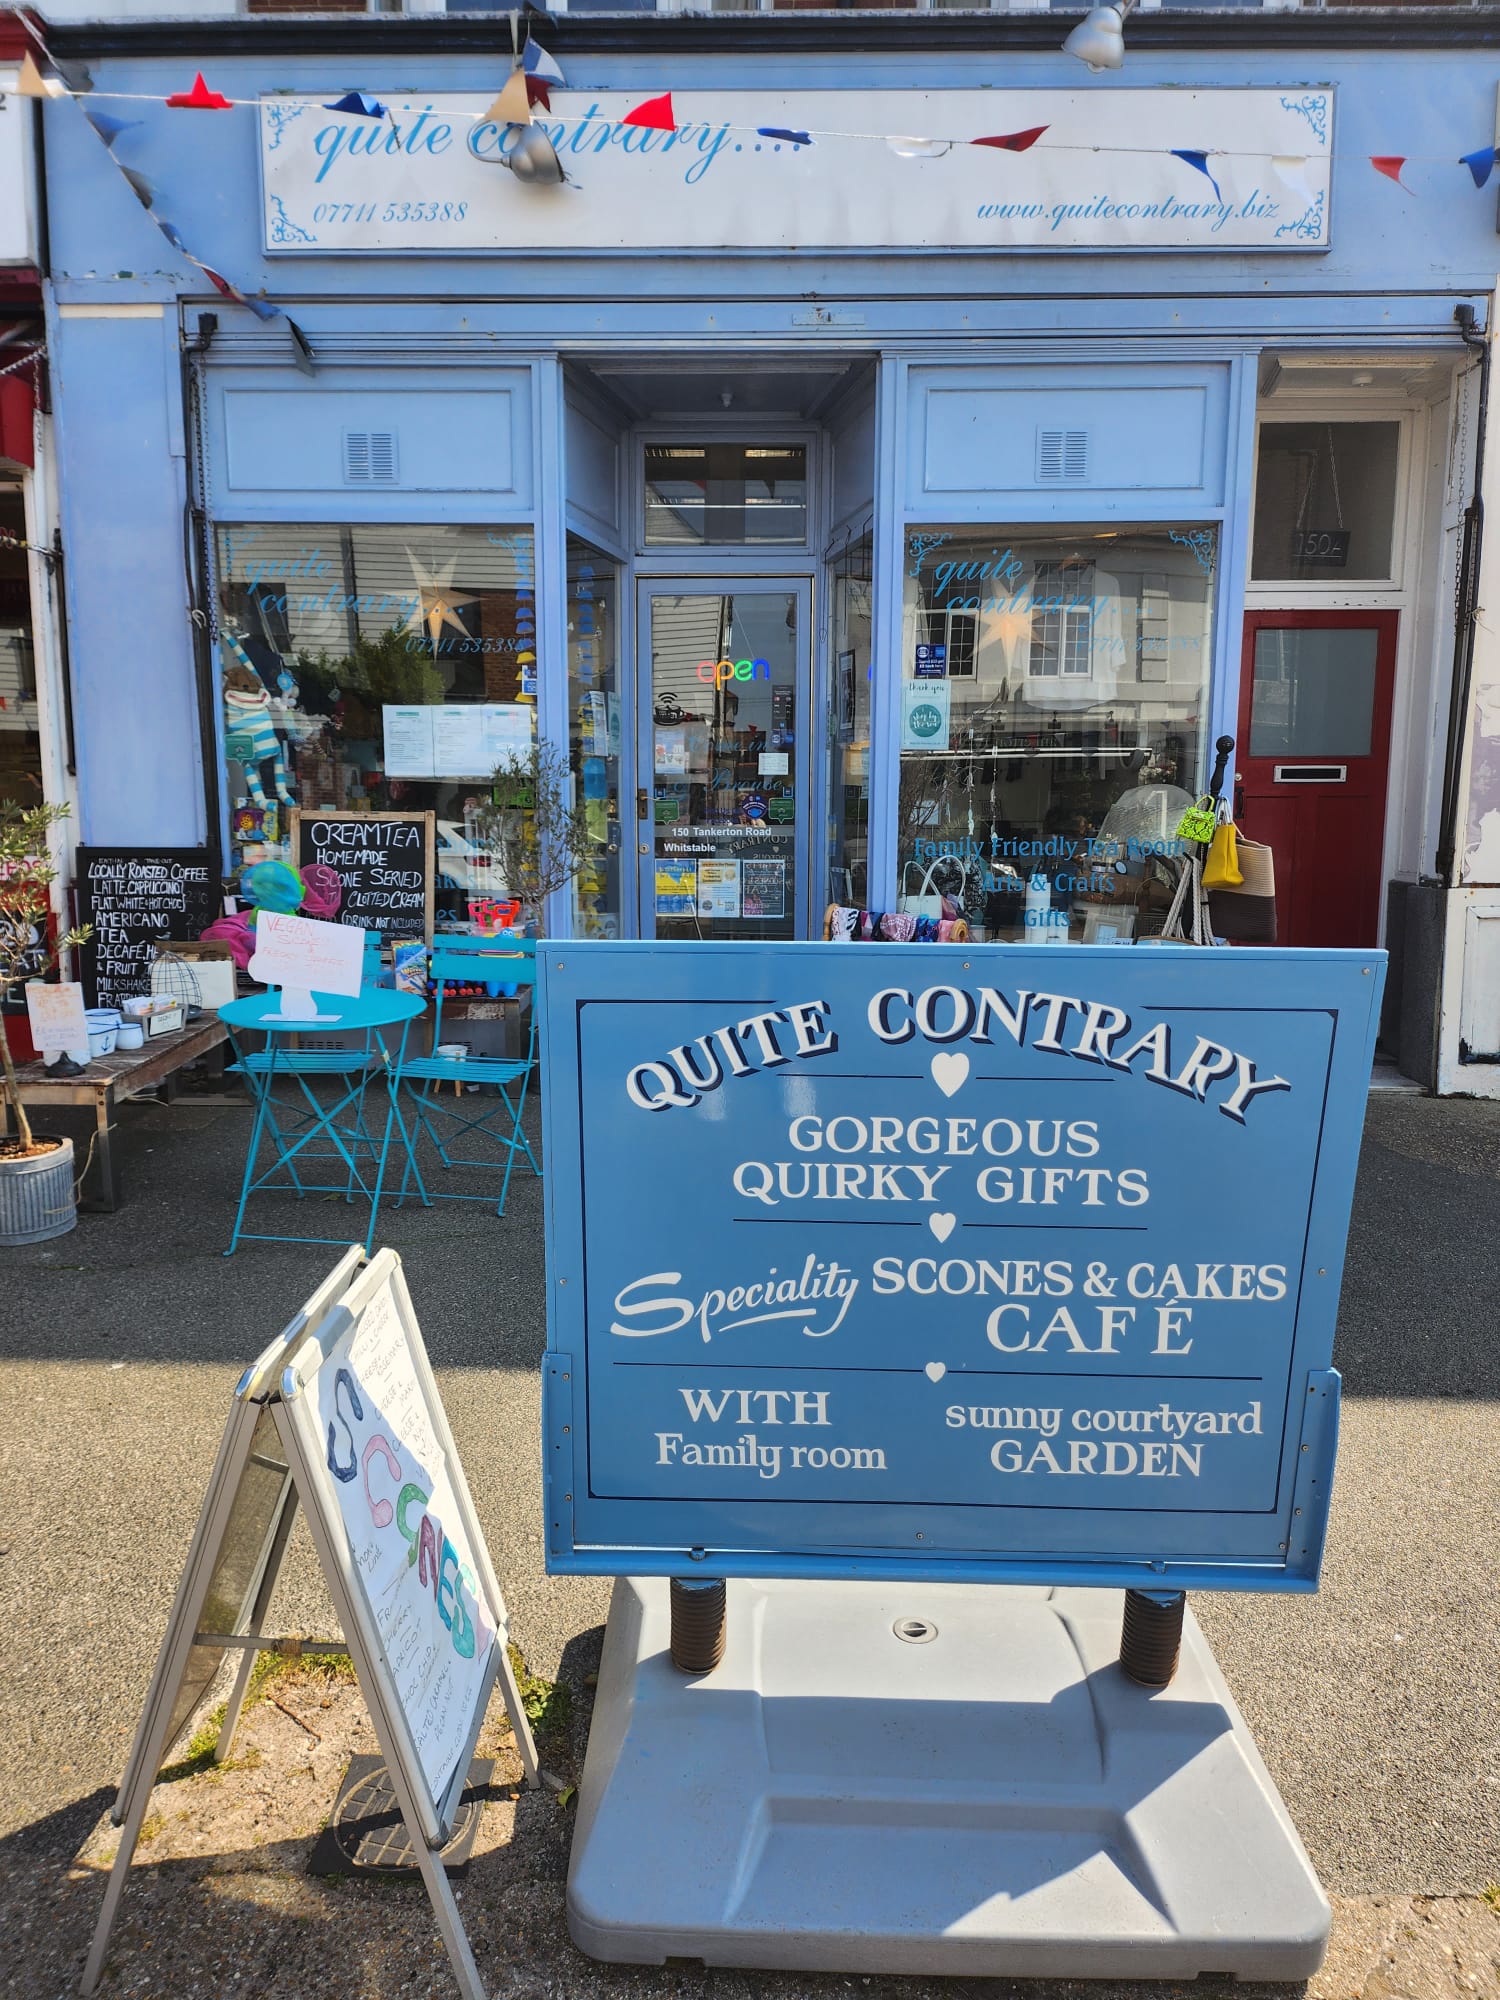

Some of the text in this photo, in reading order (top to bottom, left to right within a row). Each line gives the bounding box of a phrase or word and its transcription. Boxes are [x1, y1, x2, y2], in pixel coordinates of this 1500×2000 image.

[313, 102, 452, 184] quite
[313, 201, 468, 224] 07711 535388
[977, 190, 1280, 233] www.quitecontrary.biz
[245, 547, 333, 595] quite
[935, 549, 1024, 598] quite
[696, 658, 771, 692] open
[311, 821, 381, 846] CREAM
[381, 821, 420, 849] TEA
[672, 827, 772, 837] 150 Tankerton Road
[316, 848, 389, 865] HOMEMADE
[664, 843, 716, 852] Whitstable
[914, 836, 1186, 860] Family Friendly Tea Room
[88, 862, 209, 881] LOCALLY ROASTED COFFEE
[315, 867, 423, 889] SCONE SERVED
[981, 872, 1115, 892] Arts & Crafts
[91, 895, 115, 910] FLAT
[116, 897, 145, 910] WHITE
[149, 897, 161, 910] HOT
[162, 897, 183, 910] CHOC
[347, 891, 391, 908] CLOTTED
[390, 891, 425, 909] CREAM
[96, 912, 170, 928] AMERICANO
[266, 914, 314, 936] VEGAN
[375, 917, 388, 929] NOT
[1023, 908, 1071, 928] Gifts
[96, 927, 129, 944] TEA
[106, 961, 138, 975] FRUIT
[626, 985, 1292, 1127] QUITE CONTRARY
[789, 1116, 1100, 1157] GORGEOUS
[733, 1162, 1150, 1206] QUIRKY GIFTS
[610, 1253, 1287, 1343] Speciality SCONES & CAKES
[986, 1298, 1194, 1356] CAFÉ
[678, 1388, 832, 1425] WITH
[945, 1401, 1263, 1439] sunny courtyard
[654, 1432, 888, 1479] Family room
[991, 1439, 1205, 1477] GARDEN
